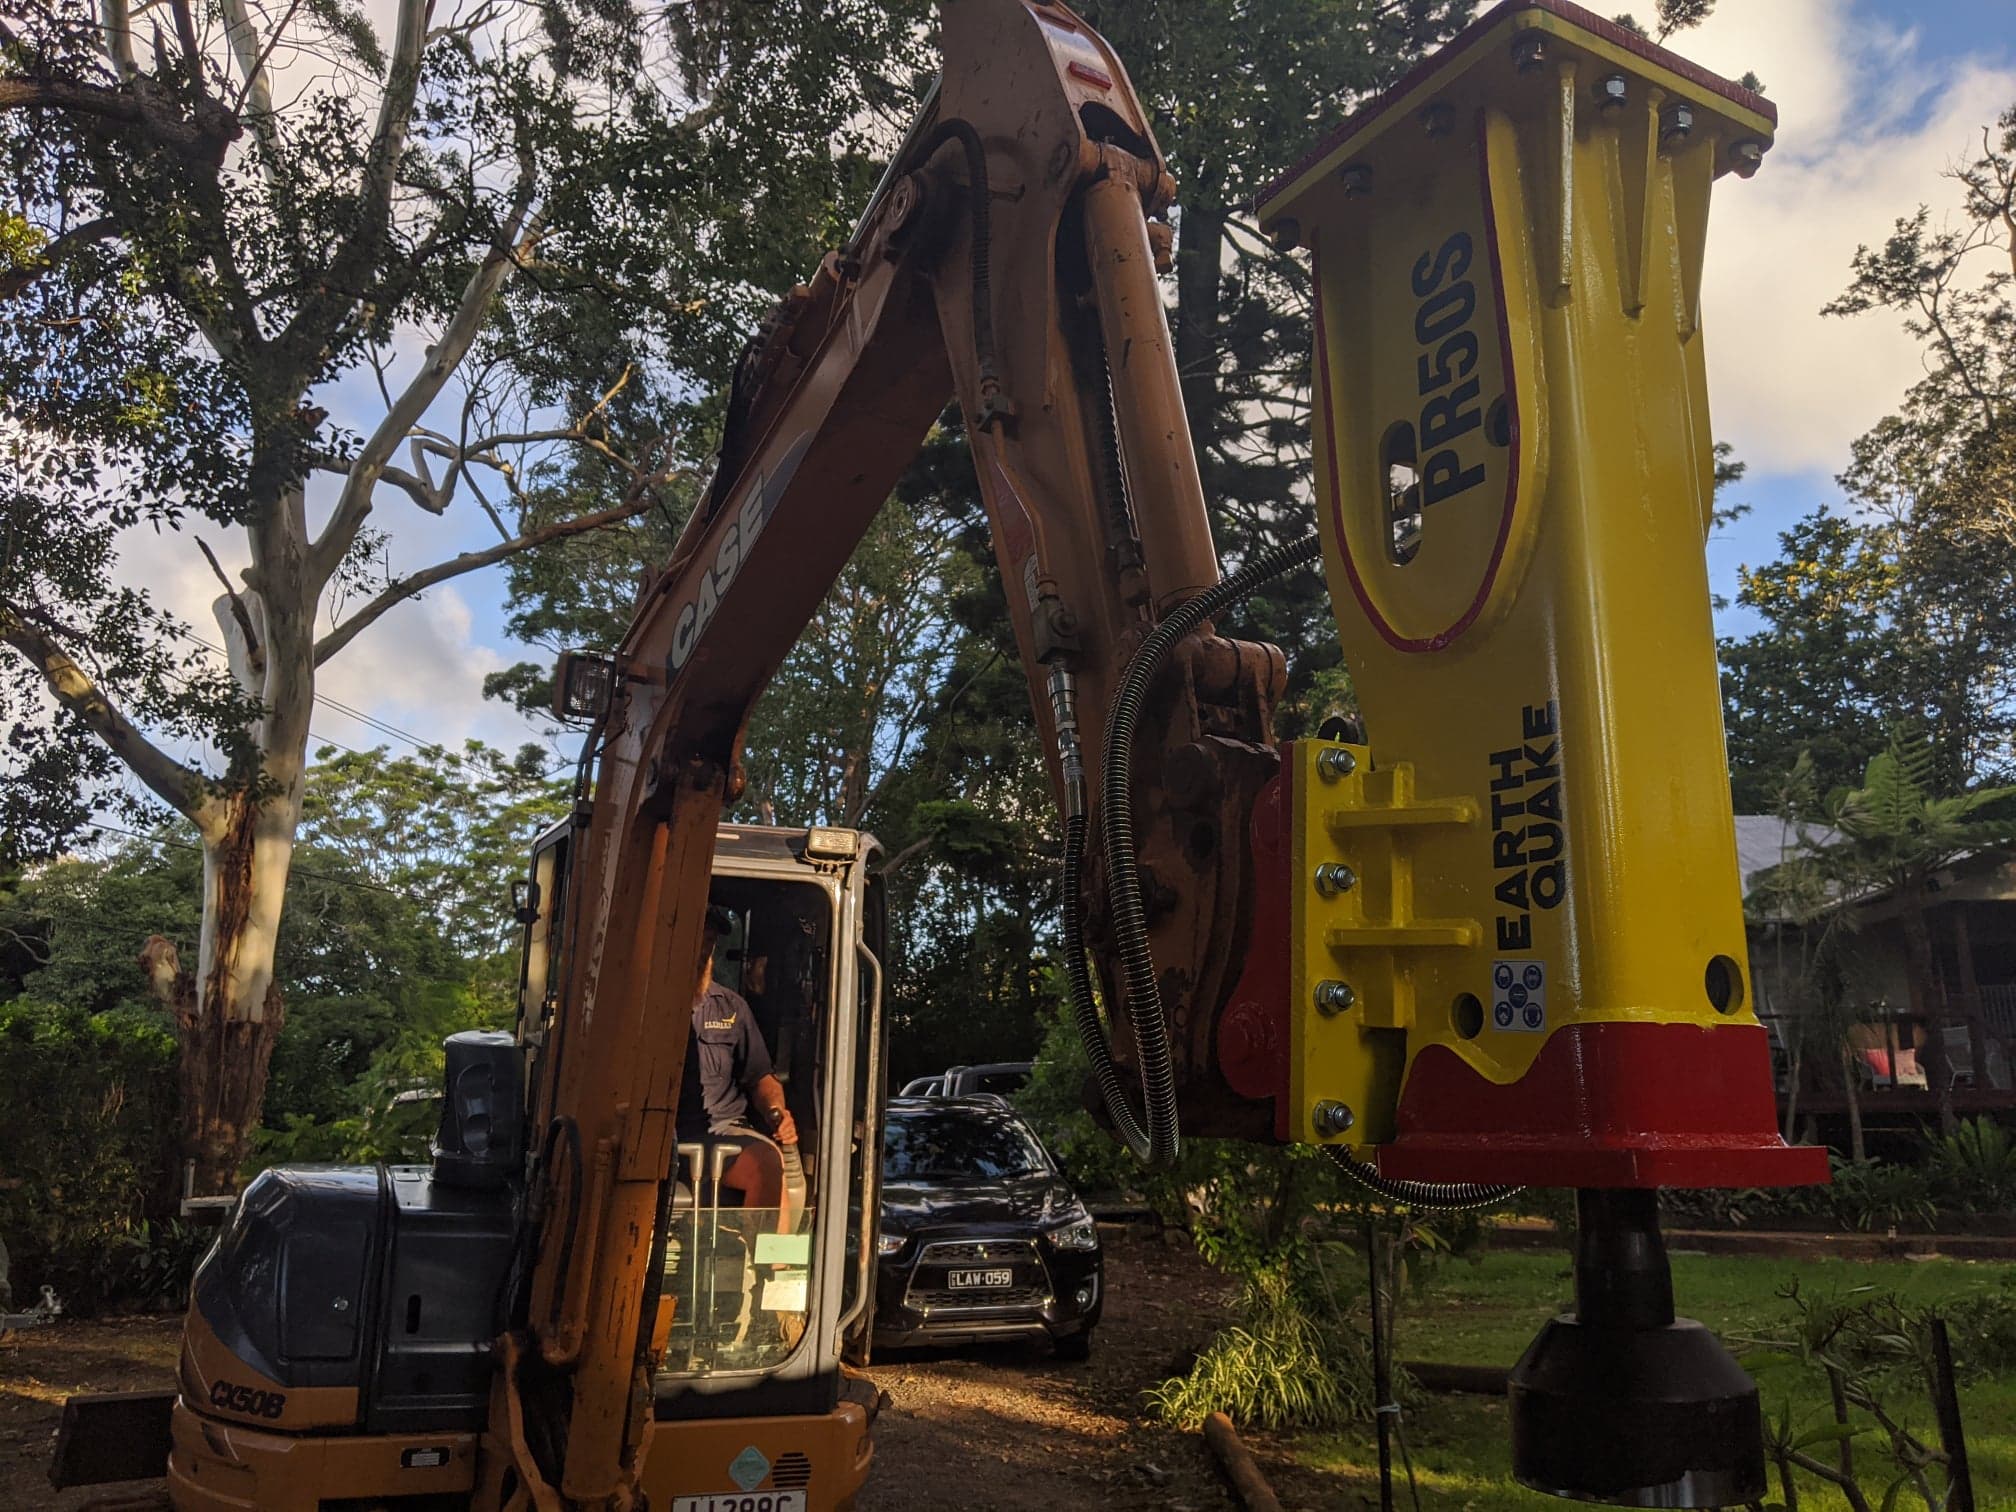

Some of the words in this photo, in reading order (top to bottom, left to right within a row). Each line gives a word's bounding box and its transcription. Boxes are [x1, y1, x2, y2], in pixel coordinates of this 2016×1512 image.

[1411, 231, 1485, 507] PR50S
[671, 472, 763, 669] CASE
[1489, 747, 1531, 951] EARTH
[1522, 699, 1566, 911] QUAKE
